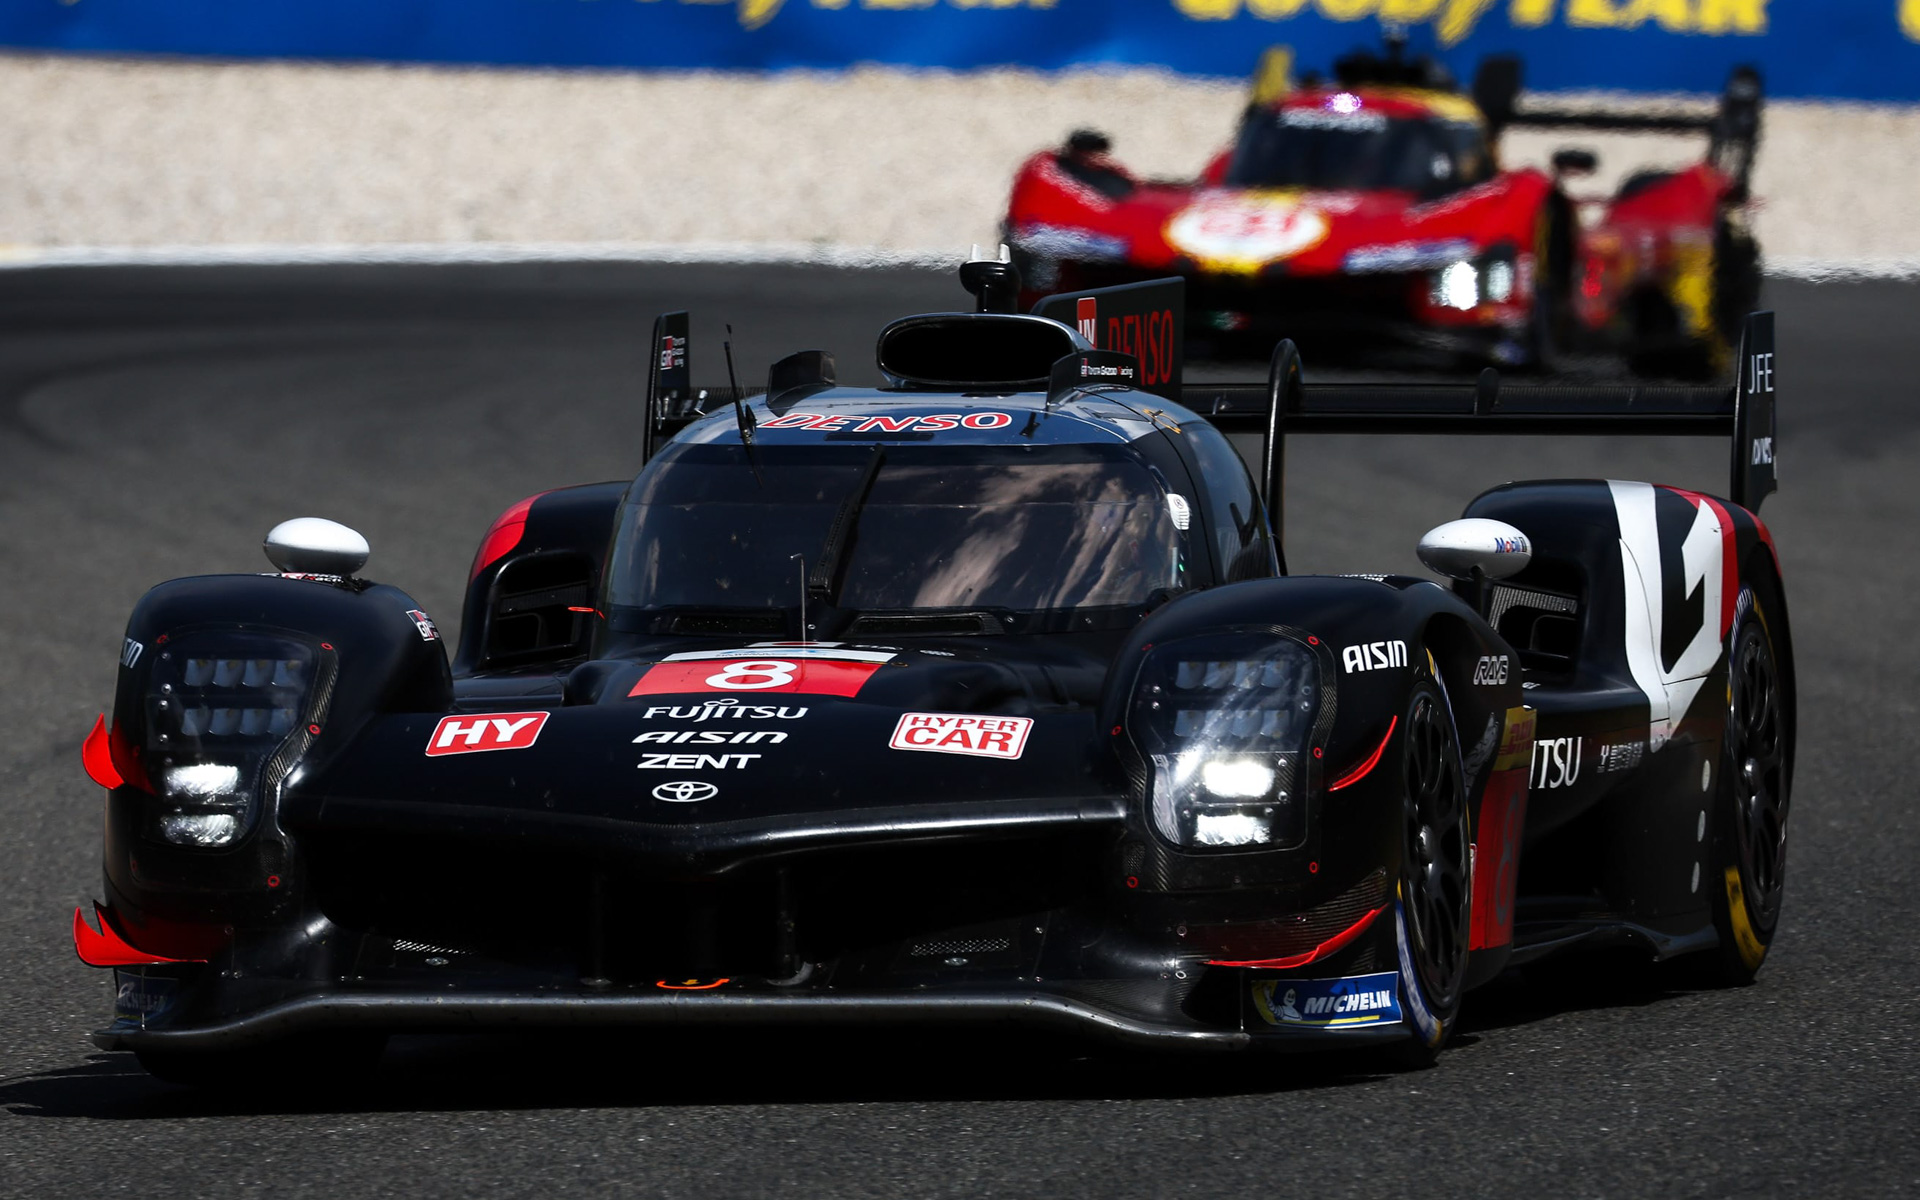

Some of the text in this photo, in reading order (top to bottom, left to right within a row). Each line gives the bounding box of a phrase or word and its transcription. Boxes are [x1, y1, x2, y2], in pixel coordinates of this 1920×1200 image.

[1748, 353, 1773, 394] JFE
[755, 412, 1012, 433] DENSO
[1342, 640, 1408, 673] AISIN
[705, 660, 797, 689] 8
[1473, 655, 1509, 685] RAYS
[642, 701, 808, 722] FUJITSU
[436, 717, 539, 748] HY
[910, 716, 1019, 732] HYPER
[632, 731, 788, 743] AISIN
[904, 727, 1013, 752] CAR
[637, 754, 762, 769] ZENT
[1304, 990, 1391, 1014] MICHELIN
